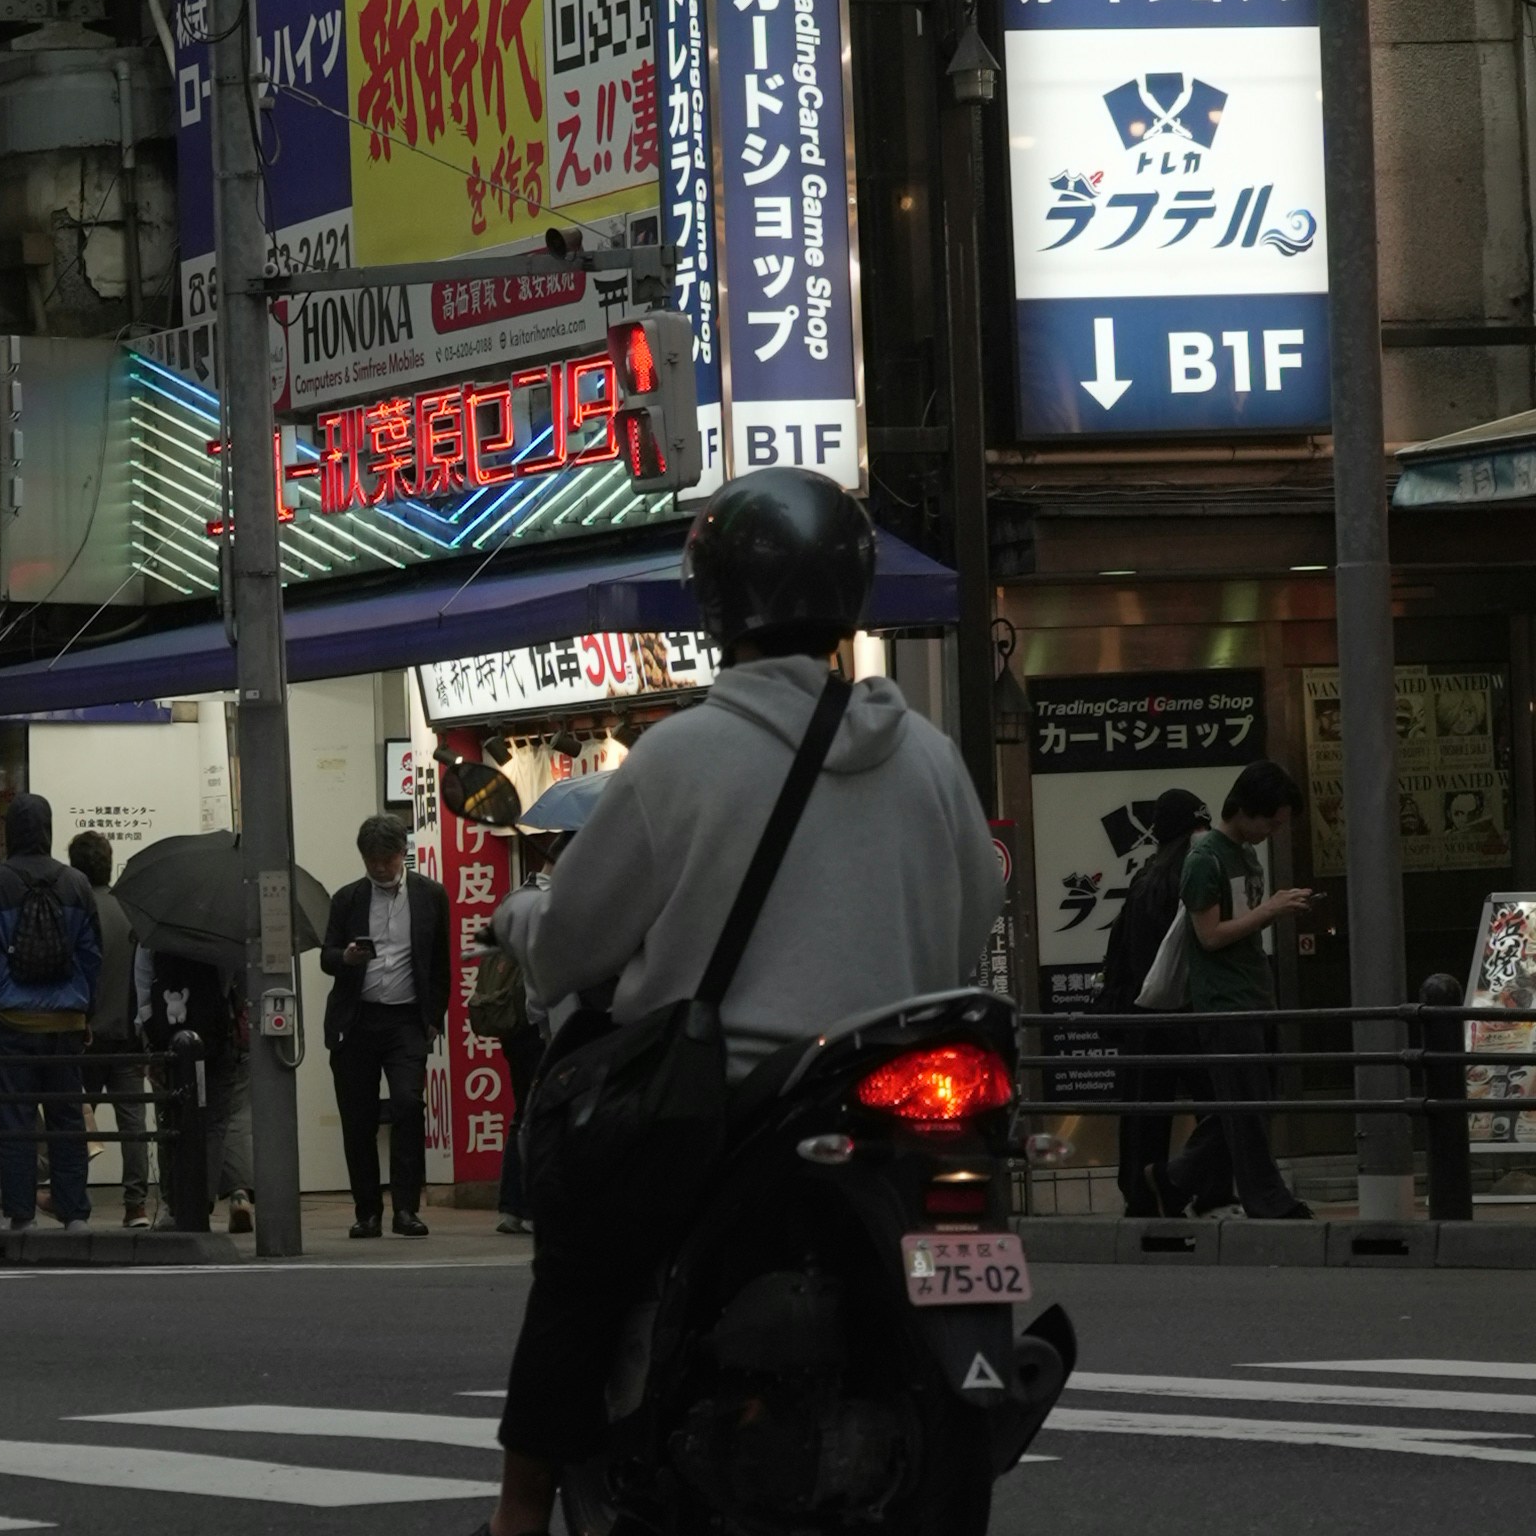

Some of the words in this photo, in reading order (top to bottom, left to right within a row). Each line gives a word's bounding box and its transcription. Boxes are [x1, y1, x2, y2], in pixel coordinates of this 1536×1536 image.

[466, 142, 545, 236] を作る
[798, 172, 829, 270] Game
[302, 282, 415, 365] HONOKA
[806, 274, 831, 361] Shop
[295, 368, 344, 396] Computers
[344, 366, 351, 385] &
[352, 354, 389, 382] Simfree
[389, 349, 426, 376] Mobiles
[1168, 330, 1305, 394] B1F
[746, 423, 843, 467] B1F
[1430, 674, 1489, 692] WANTED
[1036, 699, 1151, 717] TradingCard
[1153, 695, 1205, 713] Game
[1207, 693, 1255, 712] Shop
[1039, 714, 1255, 755] カードショップ
[1436, 772, 1494, 789] WANTED
[69, 806, 156, 815] ニュー秋葉原センター
[1055, 1082, 1073, 1092] and
[1074, 1080, 1115, 1091] Holidays
[1068, 1068, 1117, 1080] Weekends
[935, 1265, 1023, 1296] 75-02
